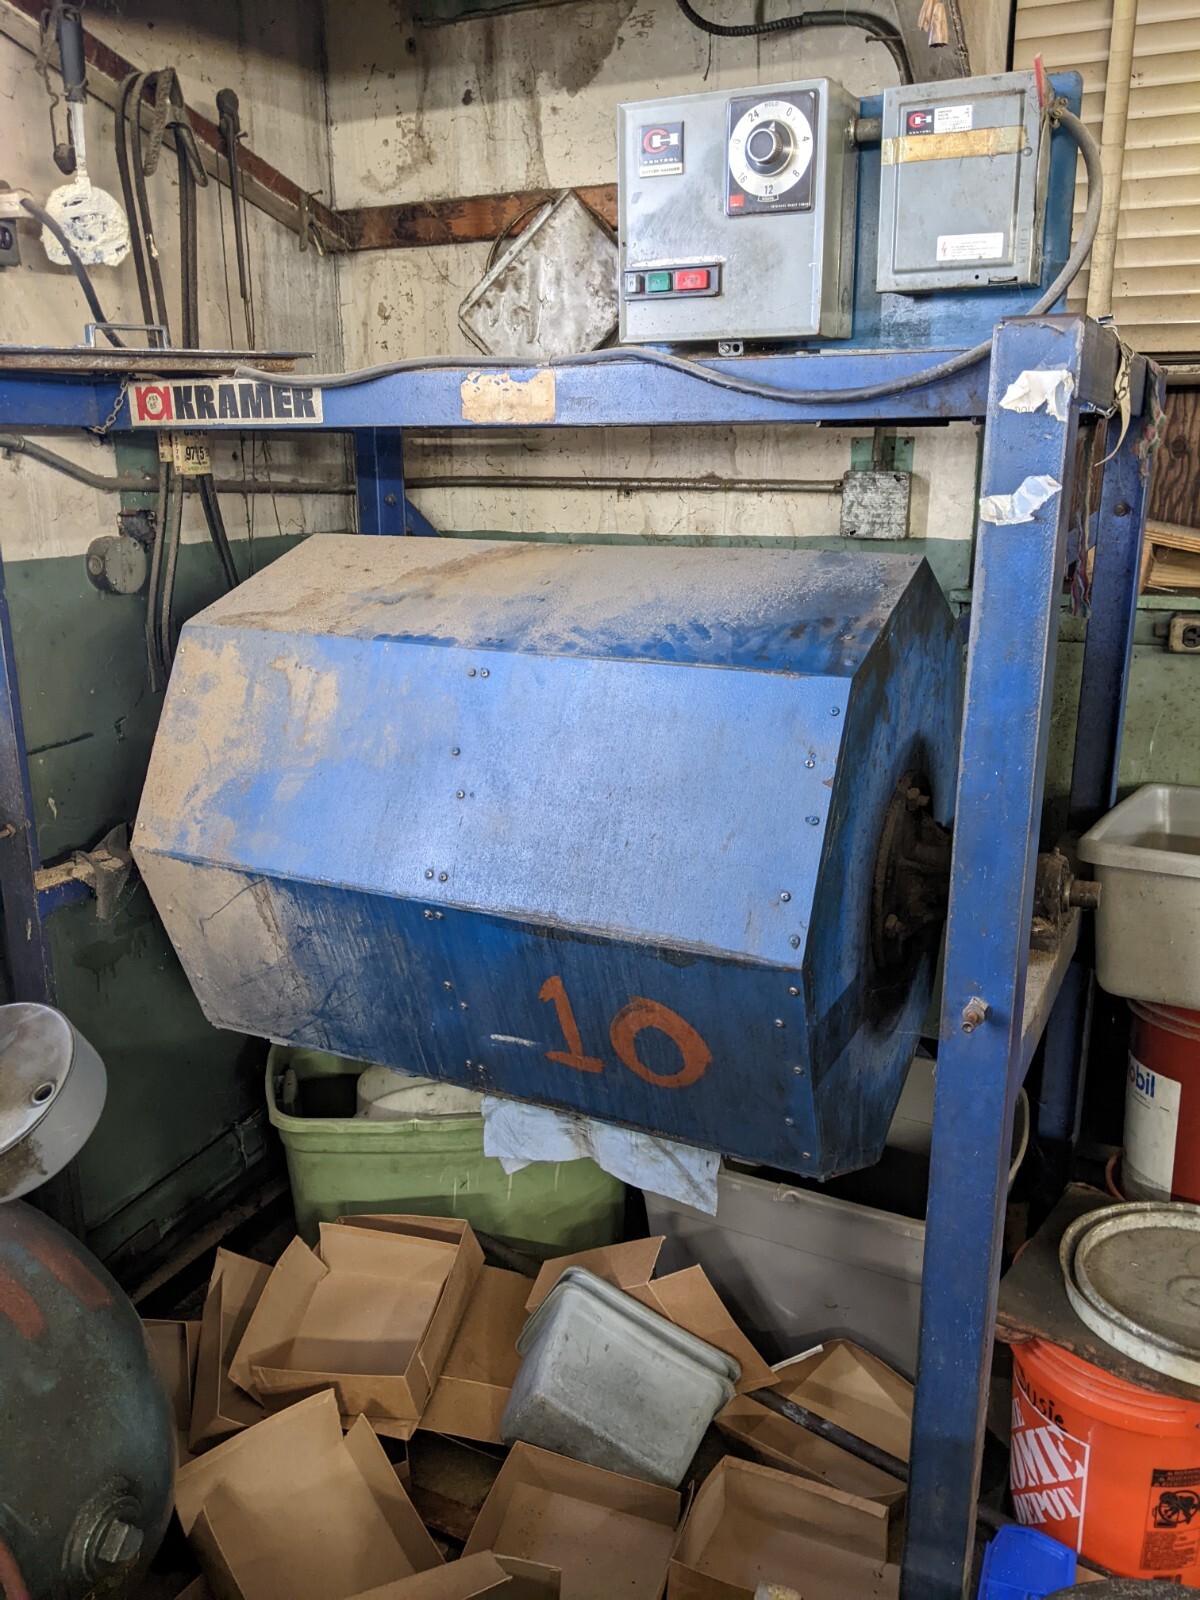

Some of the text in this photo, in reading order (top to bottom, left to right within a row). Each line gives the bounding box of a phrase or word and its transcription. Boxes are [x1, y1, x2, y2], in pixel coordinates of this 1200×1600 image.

[748, 109, 760, 122] 24
[785, 107, 793, 117] 0
[643, 157, 679, 165] CONTROL
[737, 172, 748, 184] 16
[792, 169, 800, 178] 8
[764, 184, 774, 195] 12
[173, 384, 316, 419] KRAMER
[538, 975, 713, 1088] 10
[1129, 1064, 1156, 1099] obil
[1010, 1425, 1086, 1490] OME
[1013, 1486, 1081, 1525] DEPOT
